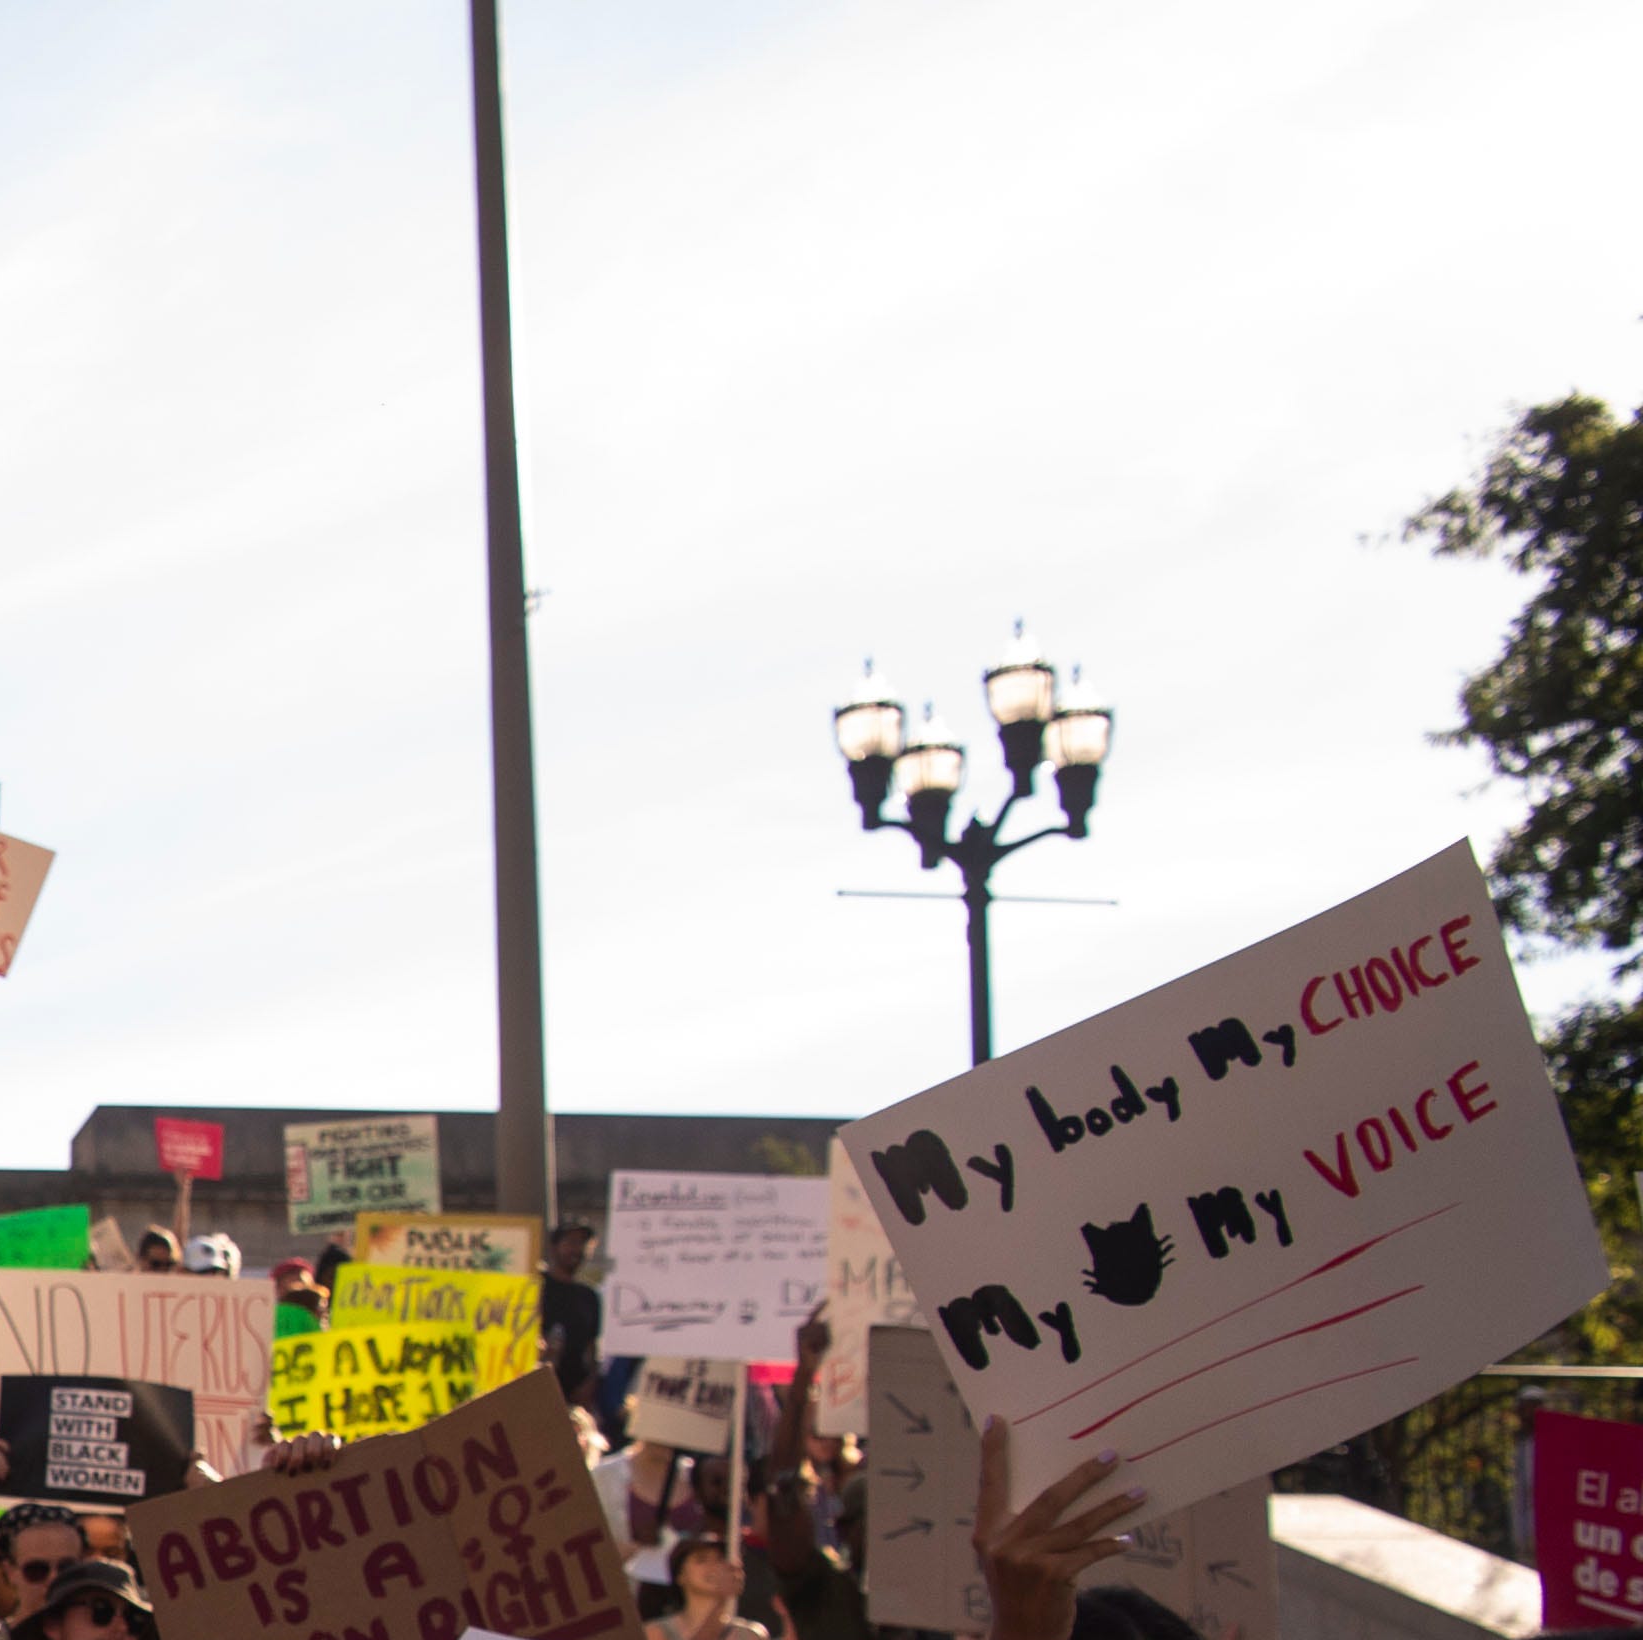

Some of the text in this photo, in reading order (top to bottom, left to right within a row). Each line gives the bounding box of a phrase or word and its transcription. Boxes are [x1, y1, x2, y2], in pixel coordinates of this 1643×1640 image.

[871, 1129, 1014, 1226] My
[1025, 1065, 1181, 1153] body
[1187, 1017, 1297, 1081] My
[1300, 914, 1482, 1037] CHOICE
[327, 1155, 402, 1181] FIGHT
[939, 1284, 1081, 1371] My
[1303, 1060, 1498, 1199] VOICE
[407, 1228, 492, 1251] PUBLIC
[117, 1288, 270, 1396] UTERUS
[271, 1334, 476, 1388] AS A WOMAN
[54, 1391, 130, 1412] STAND
[277, 1384, 409, 1431] I HOPE
[52, 1419, 113, 1436] WITH
[50, 1442, 123, 1463] BLACK
[49, 1470, 141, 1489] WOMEN
[1576, 1468, 1610, 1509] El
[157, 1420, 519, 1600] ABORTION
[1573, 1519, 1624, 1556] un
[248, 1541, 425, 1628] IS A
[1572, 1555, 1620, 1599] de
